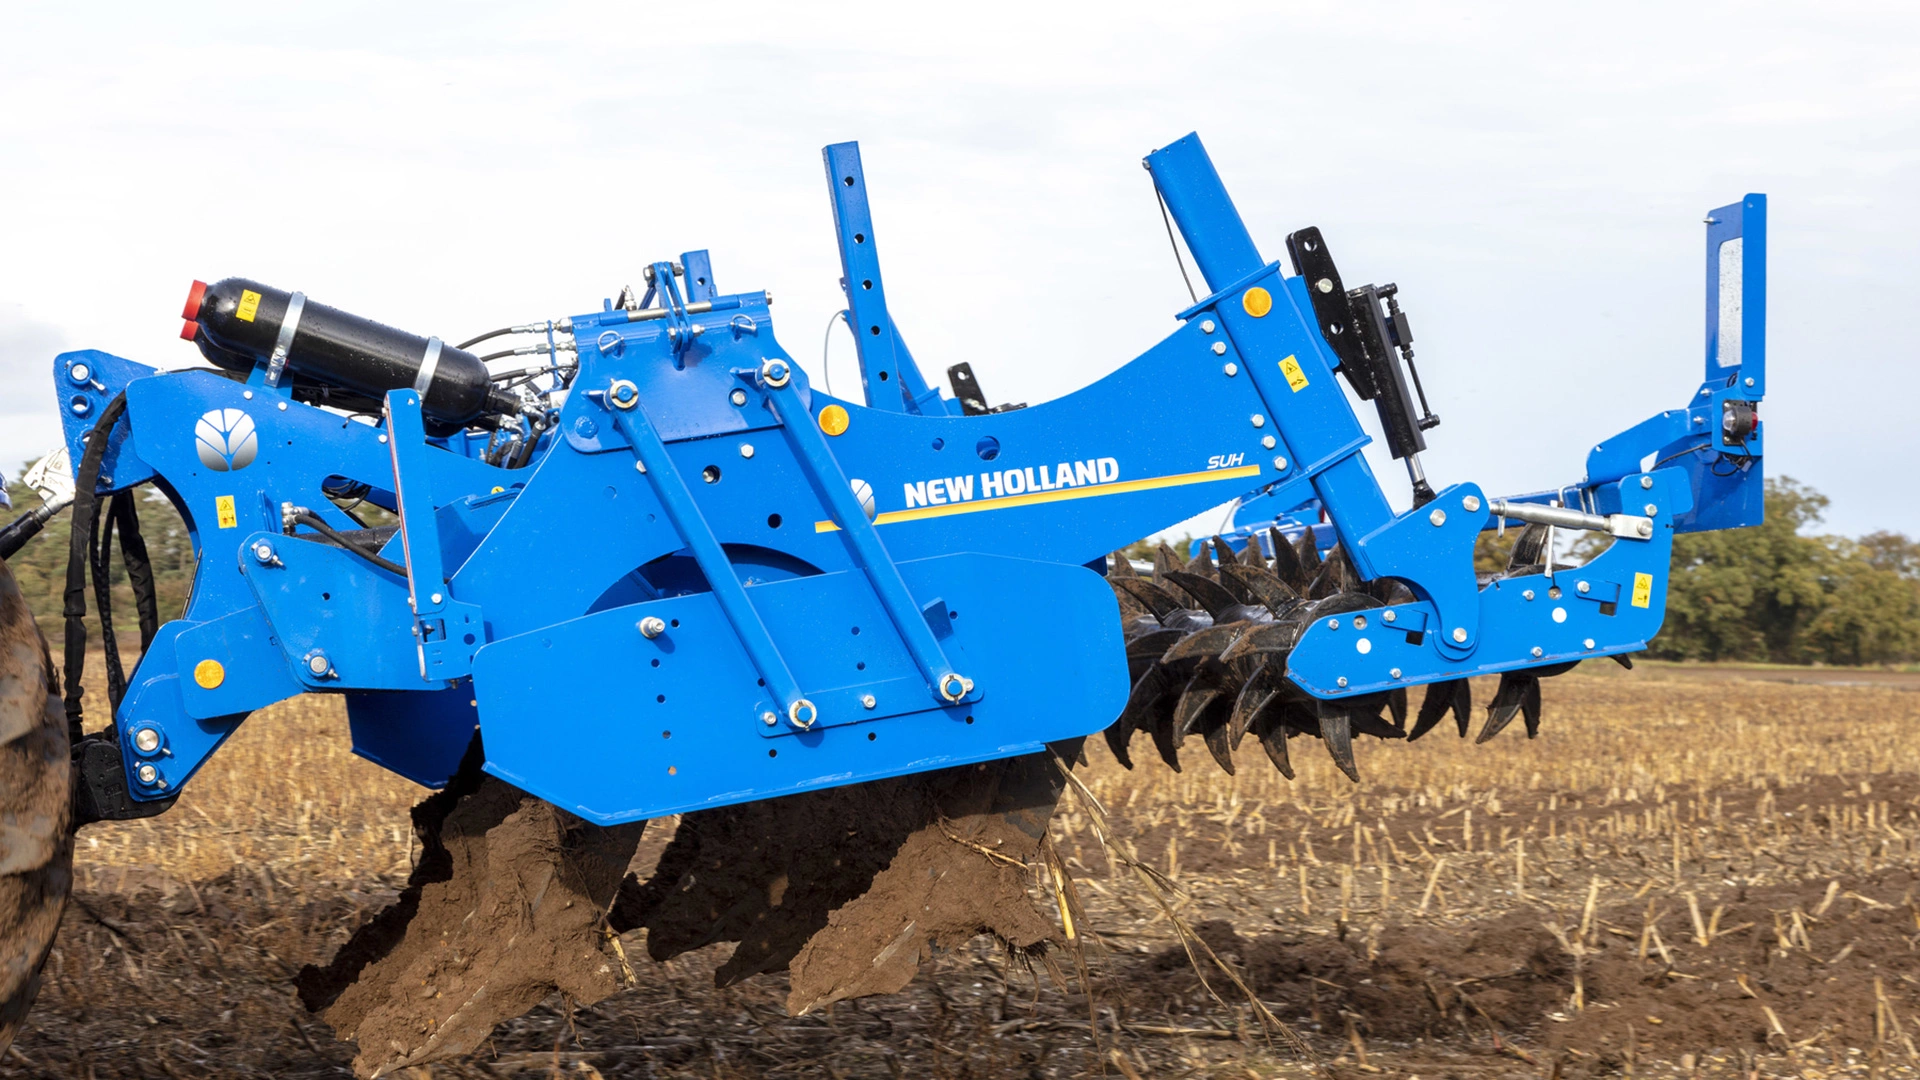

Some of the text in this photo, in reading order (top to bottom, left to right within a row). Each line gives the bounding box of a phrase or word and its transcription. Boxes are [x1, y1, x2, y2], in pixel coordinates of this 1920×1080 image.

[1207, 452, 1244, 469] SUH
[904, 457, 1119, 508] NEW HOLLAND
